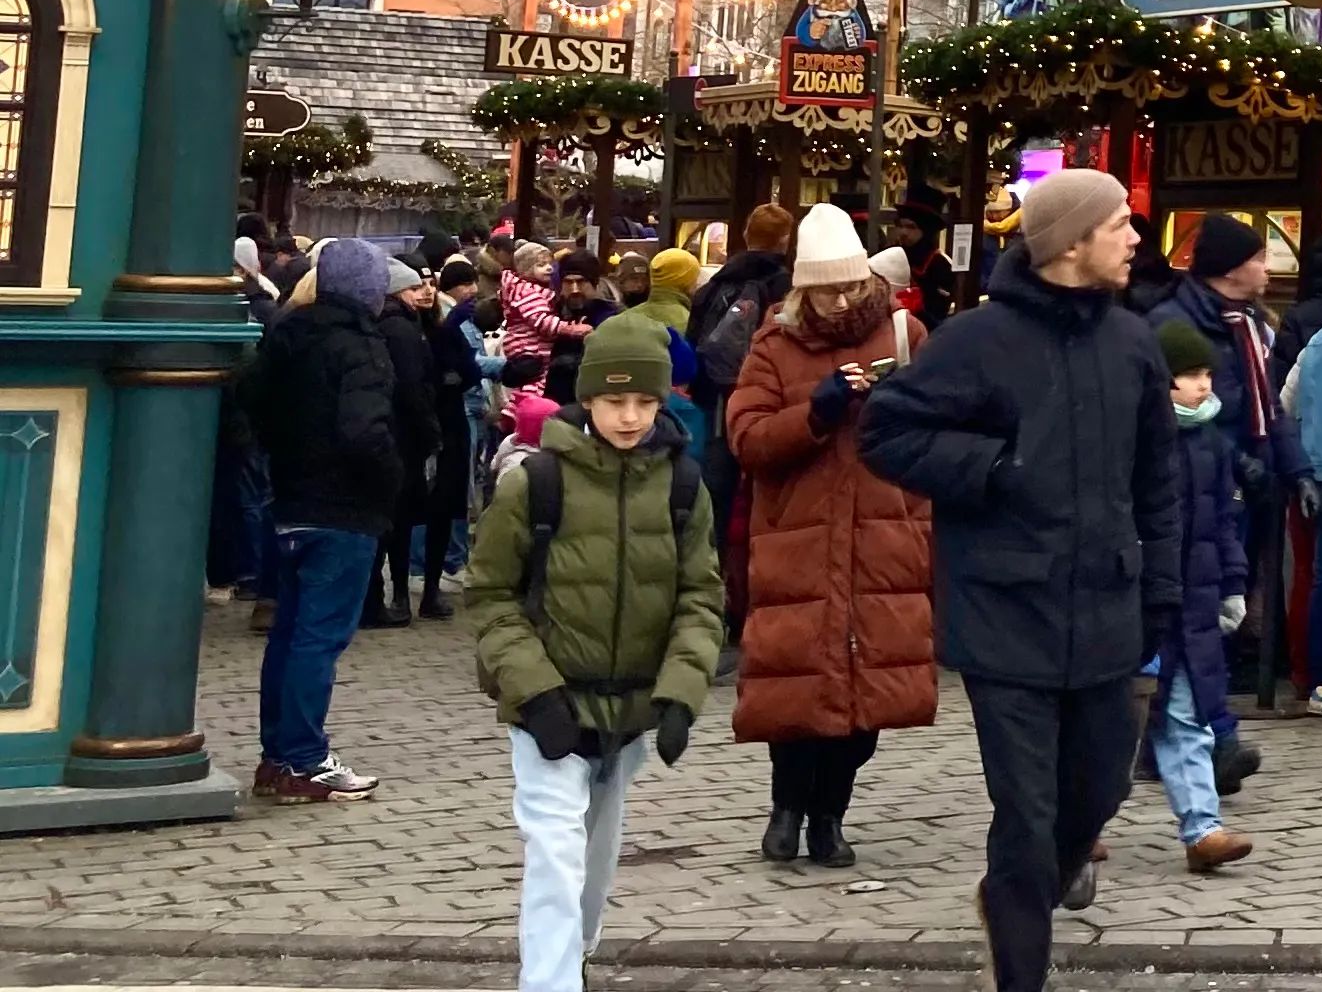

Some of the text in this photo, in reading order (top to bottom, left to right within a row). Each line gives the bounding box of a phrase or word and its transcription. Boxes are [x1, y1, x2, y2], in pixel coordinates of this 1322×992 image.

[496, 33, 627, 74] KASSE
[793, 52, 865, 73] EXPRESS
[792, 70, 865, 94] ZUGANG
[1167, 121, 1300, 176] KASSE
